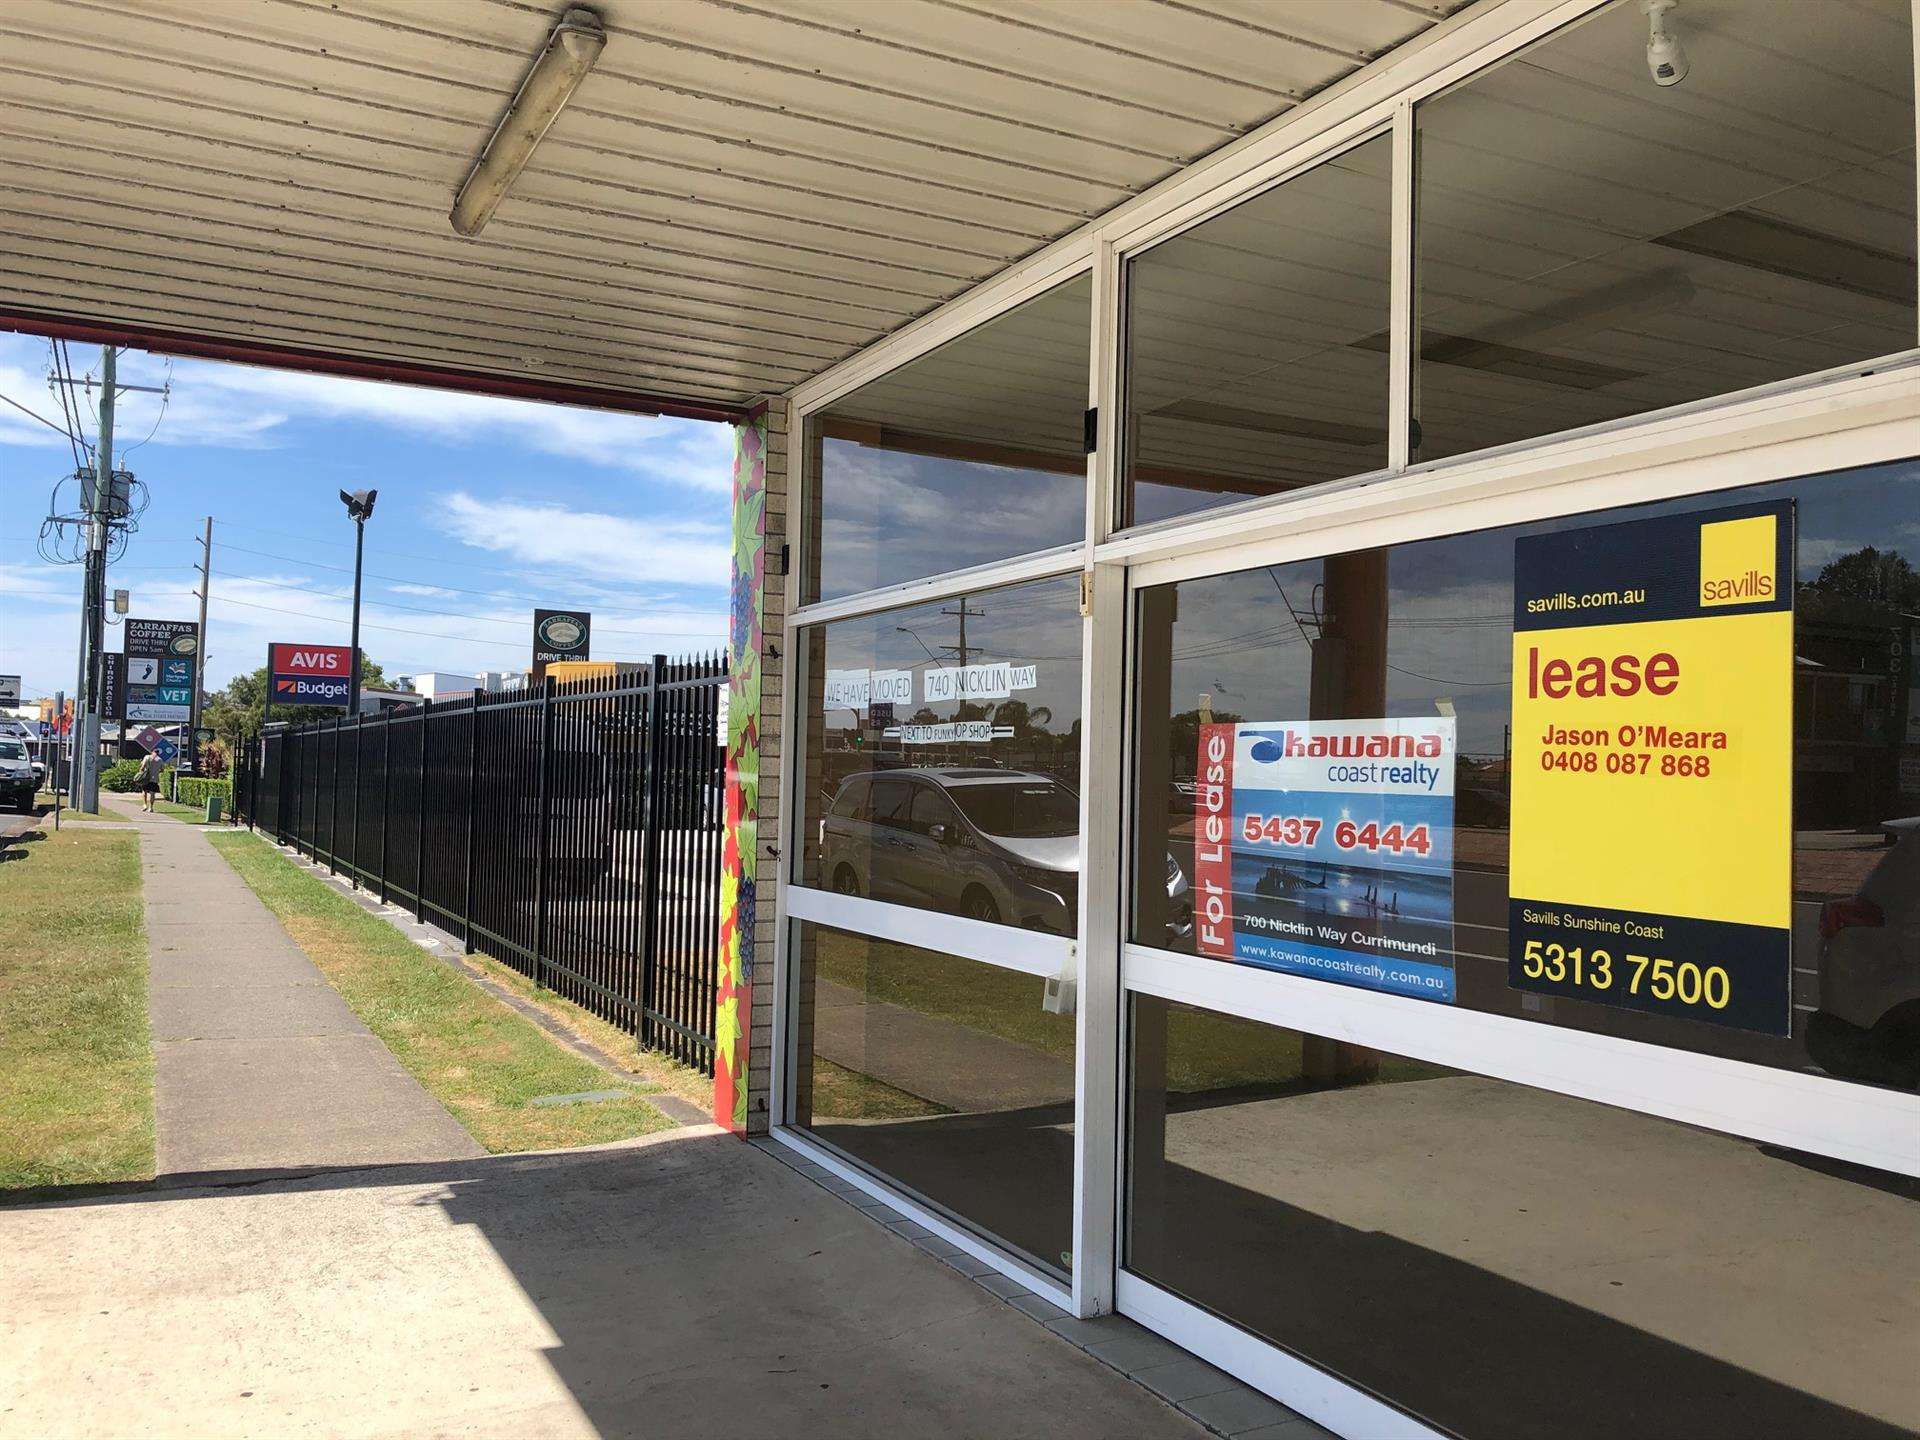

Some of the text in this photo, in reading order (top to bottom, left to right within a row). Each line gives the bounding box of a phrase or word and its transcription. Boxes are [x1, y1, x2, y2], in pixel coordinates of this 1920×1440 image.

[1704, 571, 1772, 601] savills
[1527, 589, 1645, 613] savills.com.au
[130, 622, 192, 632] ZARRAFFA'S
[130, 630, 171, 639] COFFEE
[290, 652, 337, 669] AVIS
[537, 652, 561, 661] DRIVE
[928, 665, 1036, 697] 740 NICKLIN WAY
[1528, 647, 1680, 699] lease
[162, 690, 188, 701] VET
[297, 681, 348, 698] Budget
[844, 683, 870, 703] HAVE
[872, 678, 912, 699] MOVED
[901, 727, 920, 740] NEXT
[922, 726, 933, 740] TO
[969, 724, 990, 739] SHOP
[1285, 730, 1442, 758] kawana
[1542, 724, 1609, 747] Jason
[1541, 751, 1711, 778] 0408 087 868
[1200, 735, 1226, 946] For Lease
[1243, 816, 1431, 856] 5437 6444
[1245, 915, 1436, 956] 700 Nicklin Way Currimundi
[1523, 909, 1664, 939] Savills Sunshine Coast
[1241, 943, 1444, 990] www.kawanacoastrealty.com.au
[1523, 940, 1731, 1009] 5313 7500
